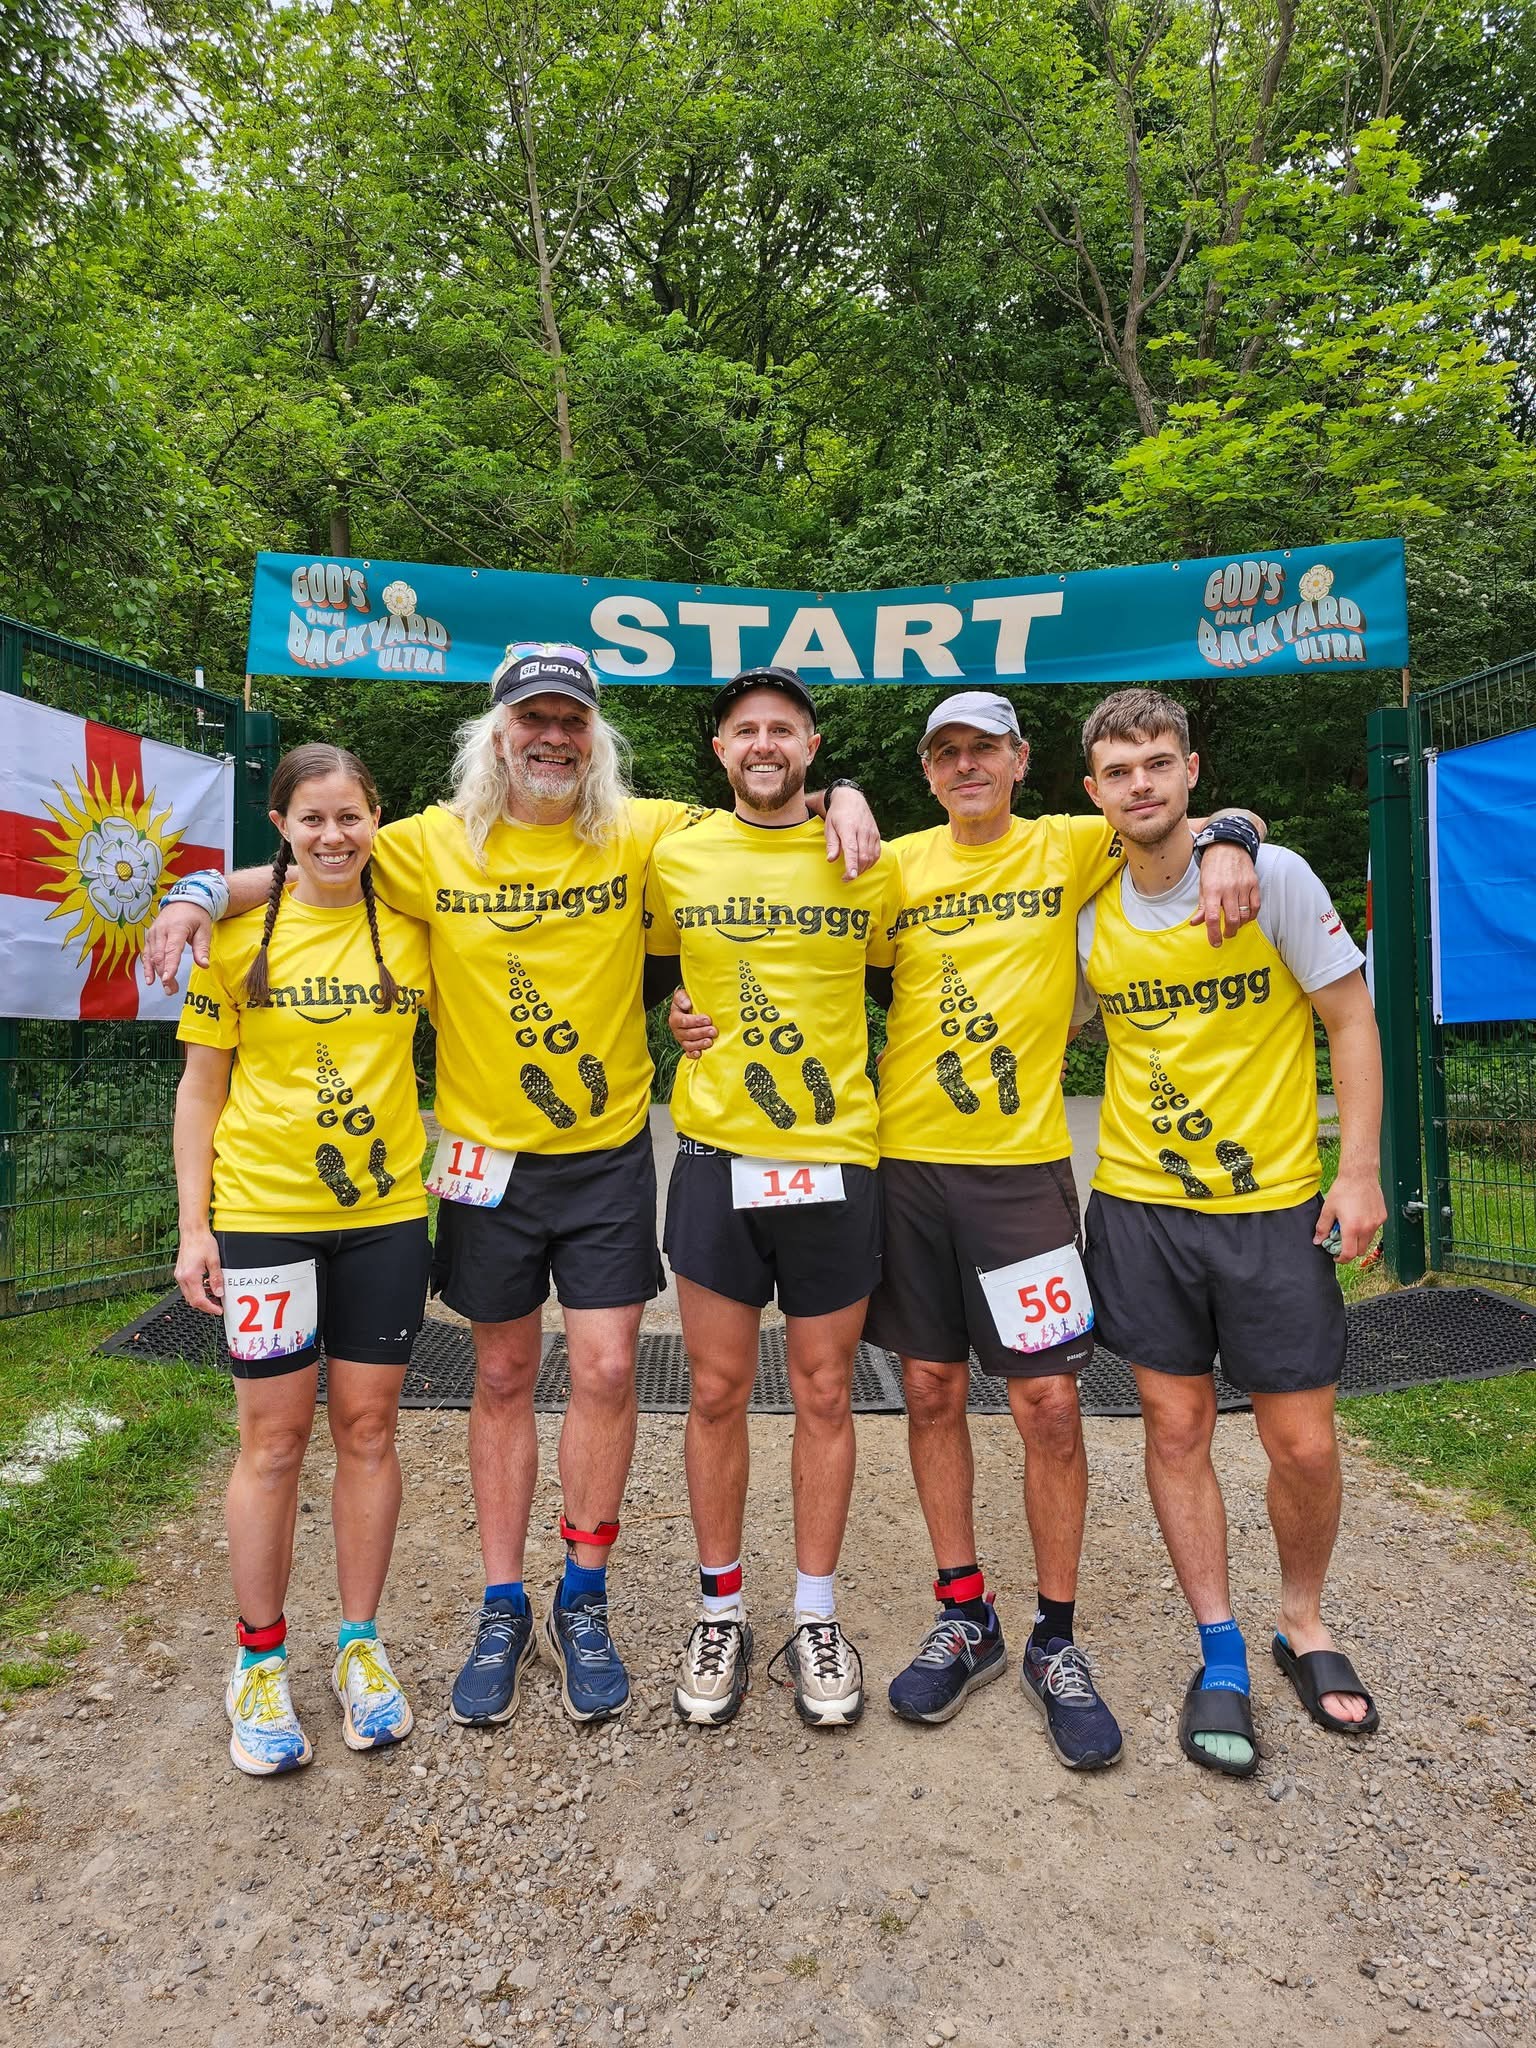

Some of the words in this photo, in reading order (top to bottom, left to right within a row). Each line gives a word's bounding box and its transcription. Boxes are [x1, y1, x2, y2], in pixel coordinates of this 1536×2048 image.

[291, 563, 369, 611] GOD'S
[1204, 560, 1284, 609] GOD'S
[288, 611, 450, 667] BACKYARD
[306, 608, 345, 627] OWN
[590, 591, 1064, 679] START
[1197, 596, 1364, 667] BACKYARD
[1214, 608, 1253, 626] OWN
[378, 647, 445, 674] ULTRA
[1295, 633, 1366, 664] ULTRA
[521, 664, 538, 677] GB
[540, 663, 581, 680] ULTRAS
[435, 873, 628, 919] smilinggg
[674, 896, 871, 941] smilinggg
[1099, 966, 1271, 1015] milinggg
[447, 1141, 488, 1181] 11
[764, 1167, 816, 1198] 14
[227, 1274, 280, 1287] ELEANOR
[1017, 1276, 1072, 1323] 56
[236, 1290, 291, 1333] 27
